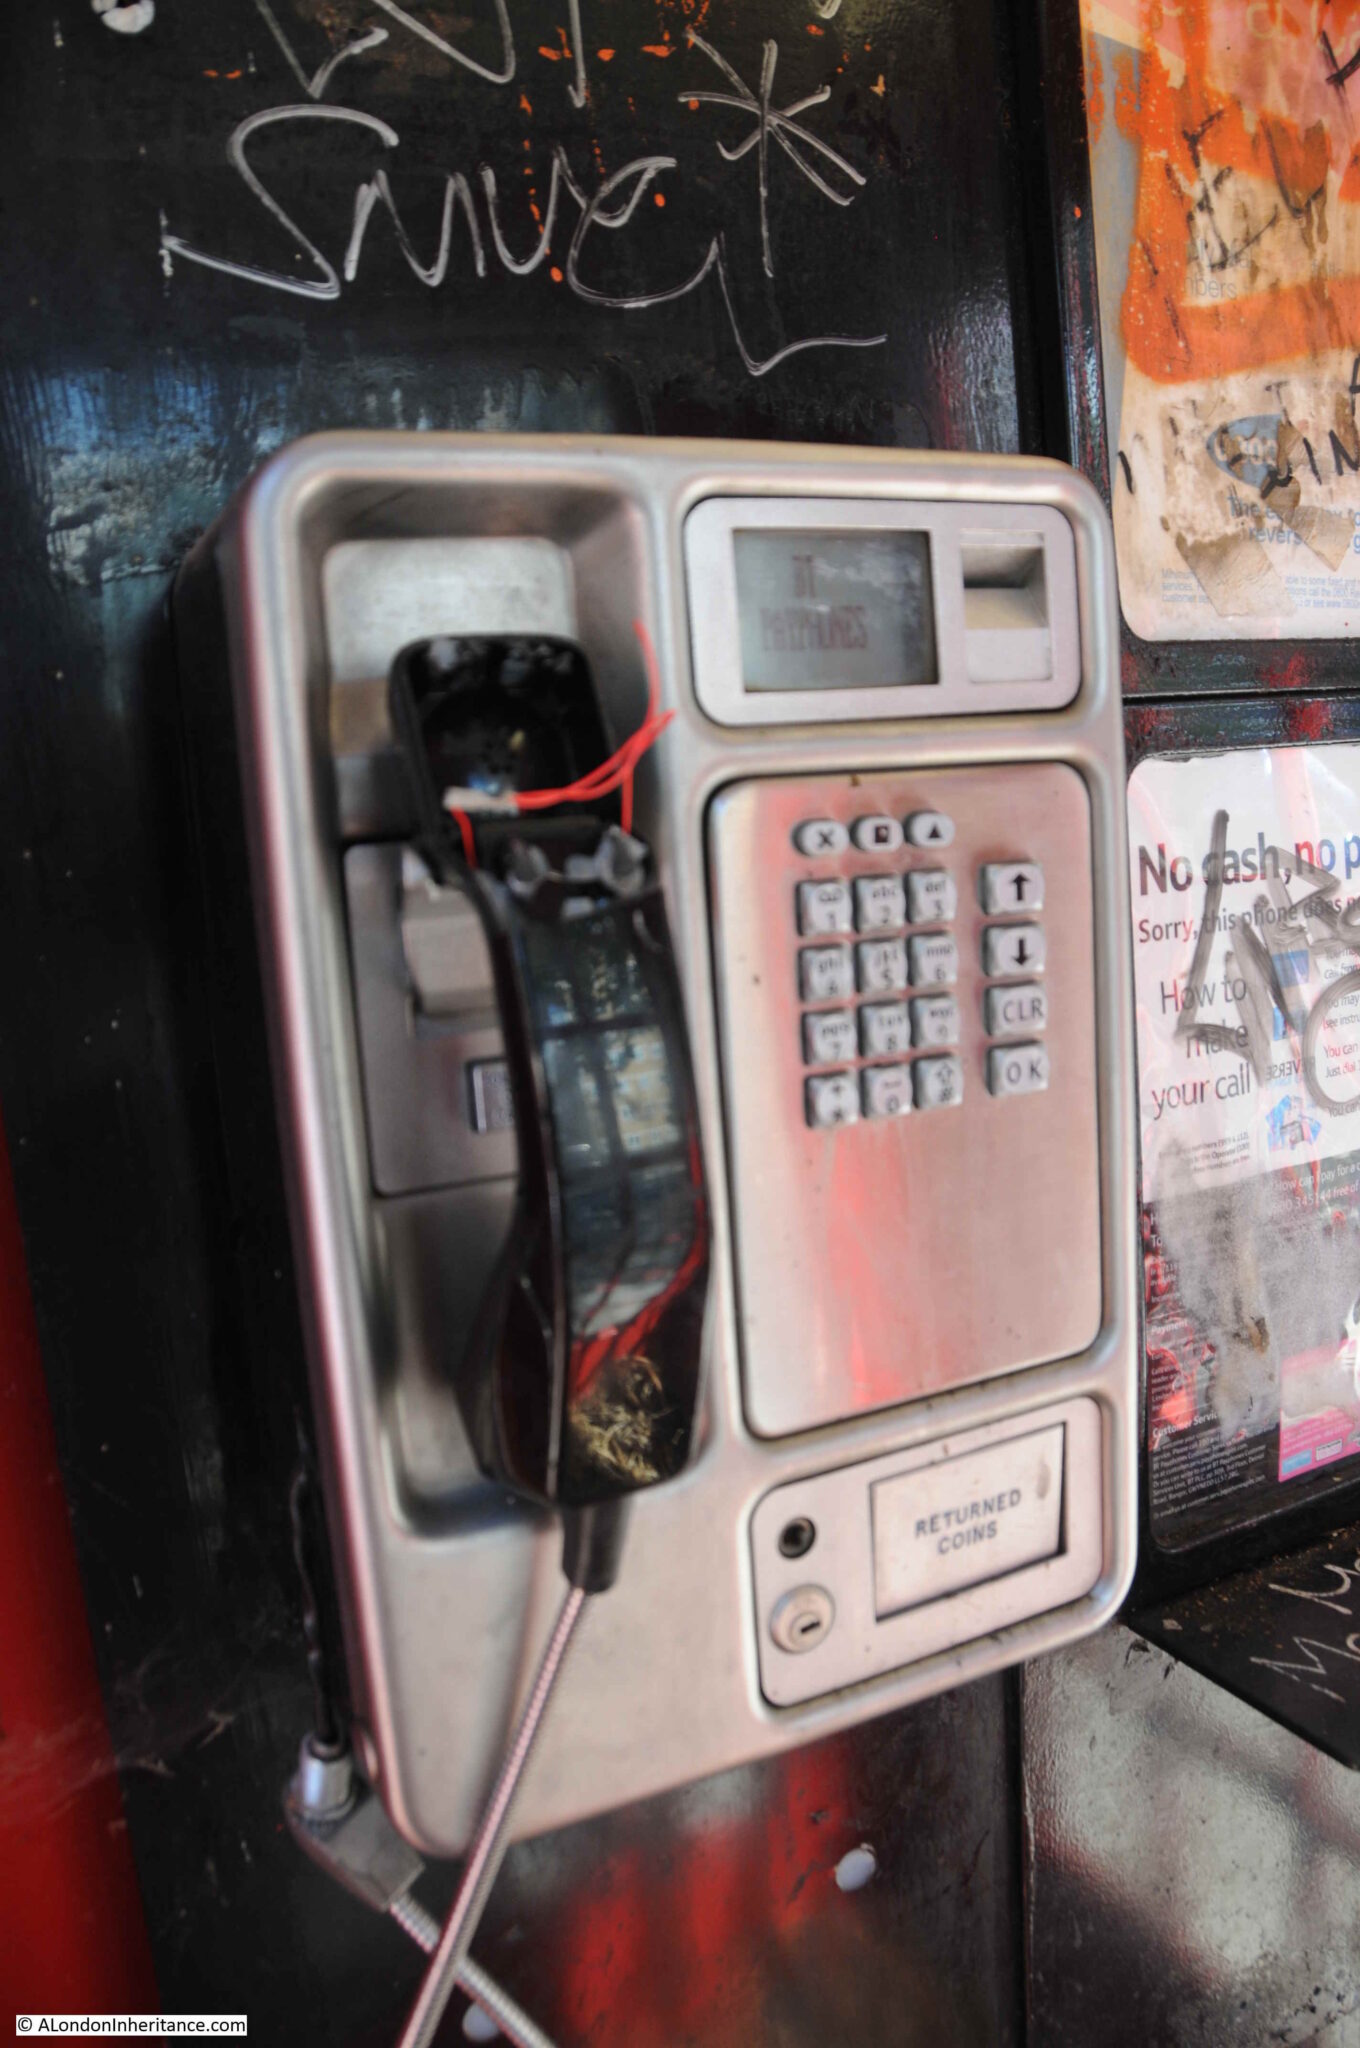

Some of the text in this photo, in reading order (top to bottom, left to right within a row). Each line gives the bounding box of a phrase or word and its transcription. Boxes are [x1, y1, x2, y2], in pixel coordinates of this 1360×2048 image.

[1138, 842, 1193, 896] No
[1201, 832, 1292, 886] cash,
[1295, 839, 1336, 876] no
[1138, 917, 1198, 944] Sorry,
[1201, 907, 1237, 934] this
[1241, 901, 1298, 930] phone
[1003, 998, 1044, 1023] CLR
[1160, 974, 1248, 1014] How to
[1186, 1018, 1249, 1058] make
[1151, 1062, 1251, 1121] your call
[914, 1488, 1022, 1538] RETURNED
[937, 1520, 998, 1555] COINS
